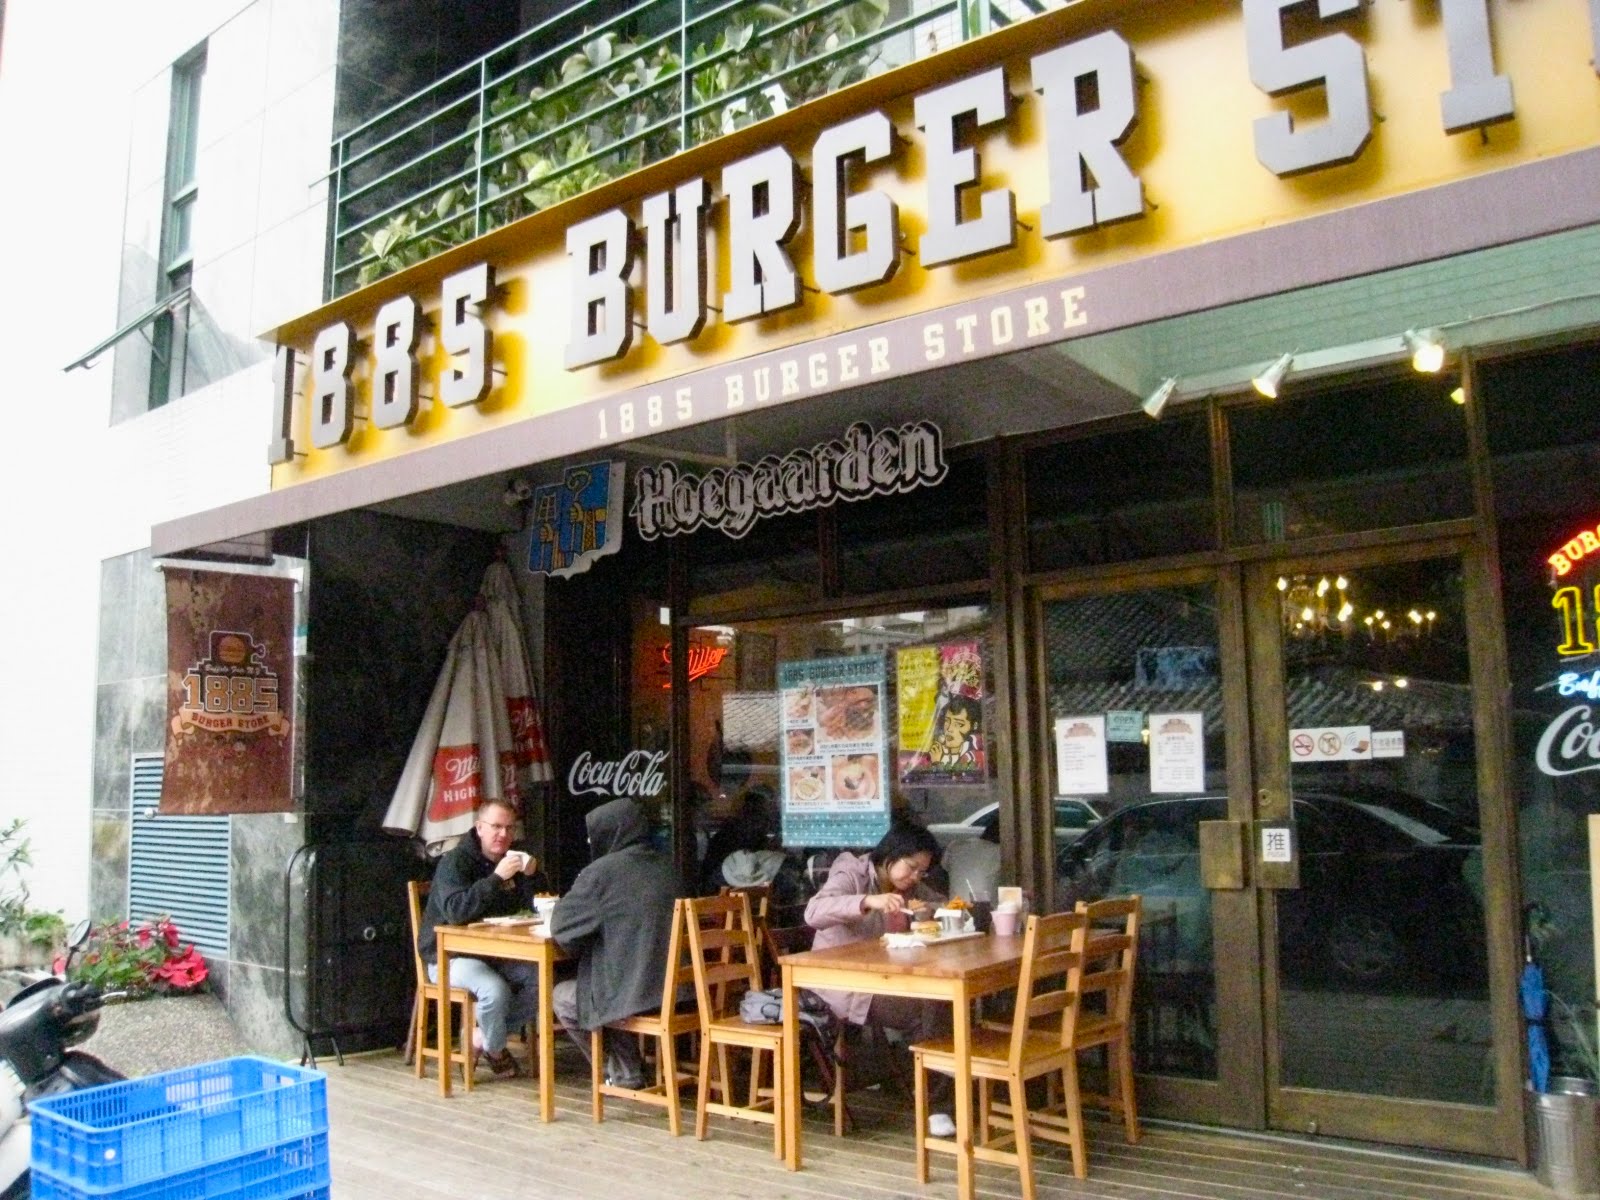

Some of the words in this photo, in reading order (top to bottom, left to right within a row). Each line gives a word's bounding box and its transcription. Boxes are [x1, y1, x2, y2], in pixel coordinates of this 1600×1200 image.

[267, 262, 496, 465] 1885
[565, 29, 1146, 372] BURGER
[1242, 0, 1600, 180] ST
[597, 387, 692, 439] 1885
[725, 336, 891, 409] BURGER
[922, 286, 1088, 361] STORE
[630, 420, 949, 541] Hoegaarden
[1547, 523, 1600, 576] BUR
[1551, 585, 1600, 656] 1
[182, 674, 279, 714] 1885
[1558, 670, 1600, 699] Buf
[191, 712, 233, 729] BURGER
[238, 715, 271, 729] STORE
[443, 786, 477, 803] HIGH
[568, 750, 671, 797] Coca-Cola
[1266, 832, 1285, 851] 推
